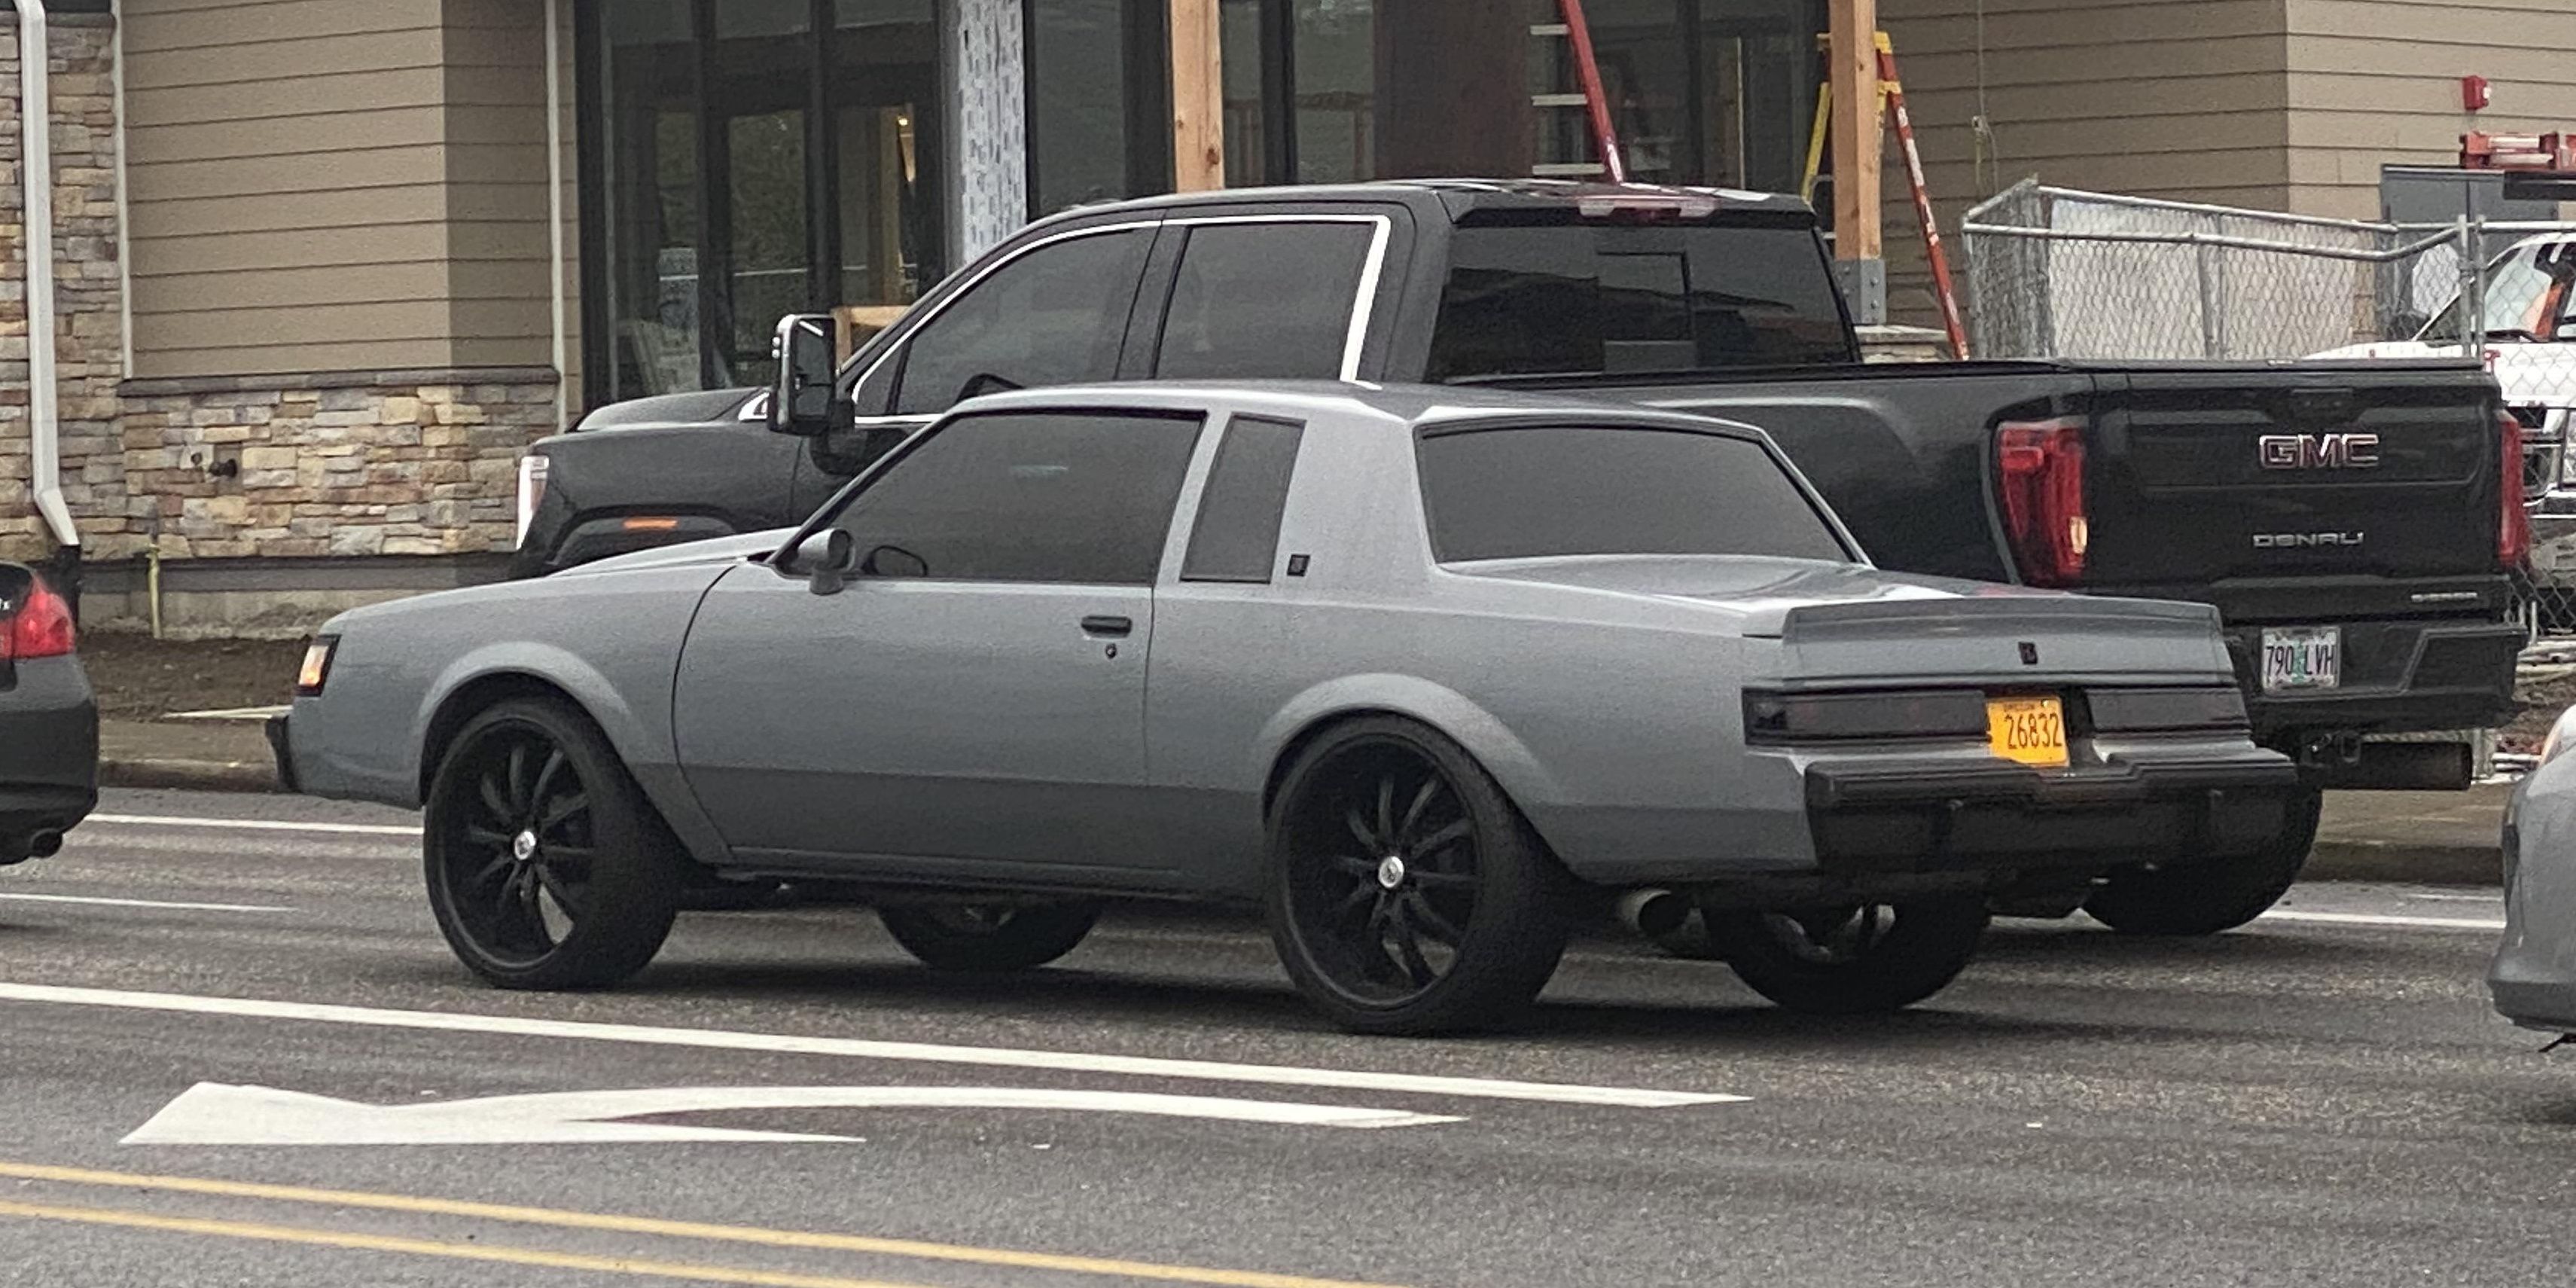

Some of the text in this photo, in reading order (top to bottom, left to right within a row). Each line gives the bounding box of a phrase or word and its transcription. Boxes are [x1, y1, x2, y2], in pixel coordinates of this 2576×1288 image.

[2259, 434, 2379, 469] GMC
[2253, 533, 2364, 547] DENALI
[2266, 646, 2294, 676] 790
[2004, 713, 2062, 749] 26832
